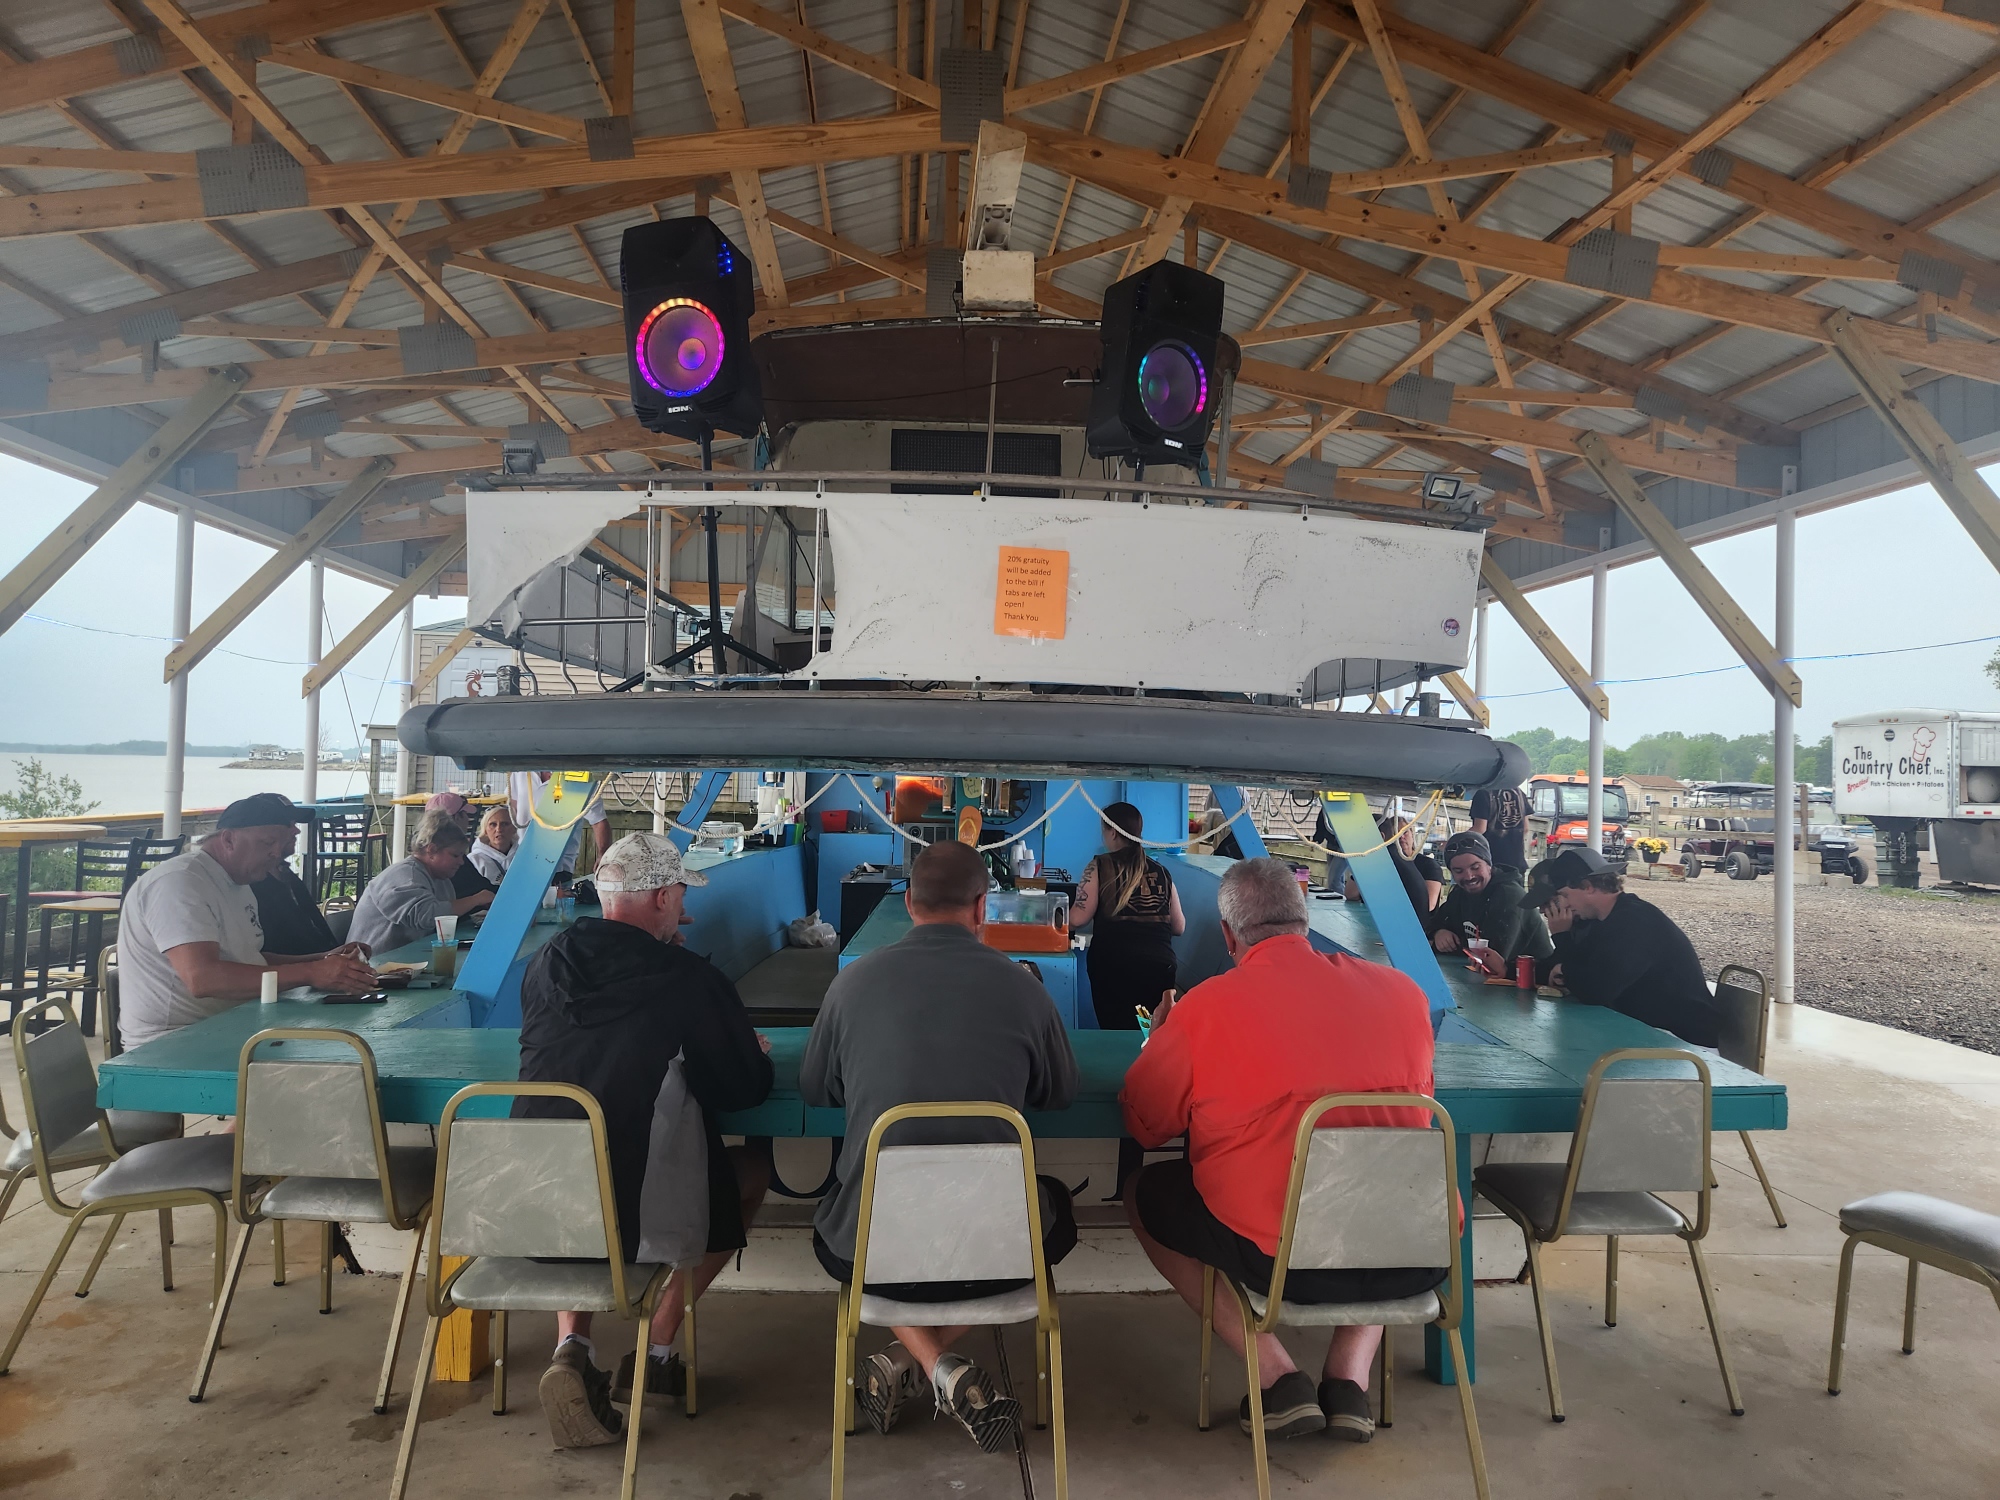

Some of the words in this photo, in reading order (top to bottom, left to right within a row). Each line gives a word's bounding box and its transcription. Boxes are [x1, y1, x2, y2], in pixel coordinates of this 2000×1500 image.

[1007, 555, 1022, 563] 20%
[1023, 557, 1050, 565] gratuity
[1030, 568, 1051, 576] added
[1039, 579, 1045, 587] if
[1004, 612, 1024, 620] Thank
[1854, 745, 1873, 760] The
[1842, 757, 1893, 780] Country
[1933, 766, 1945, 775] Inc.
